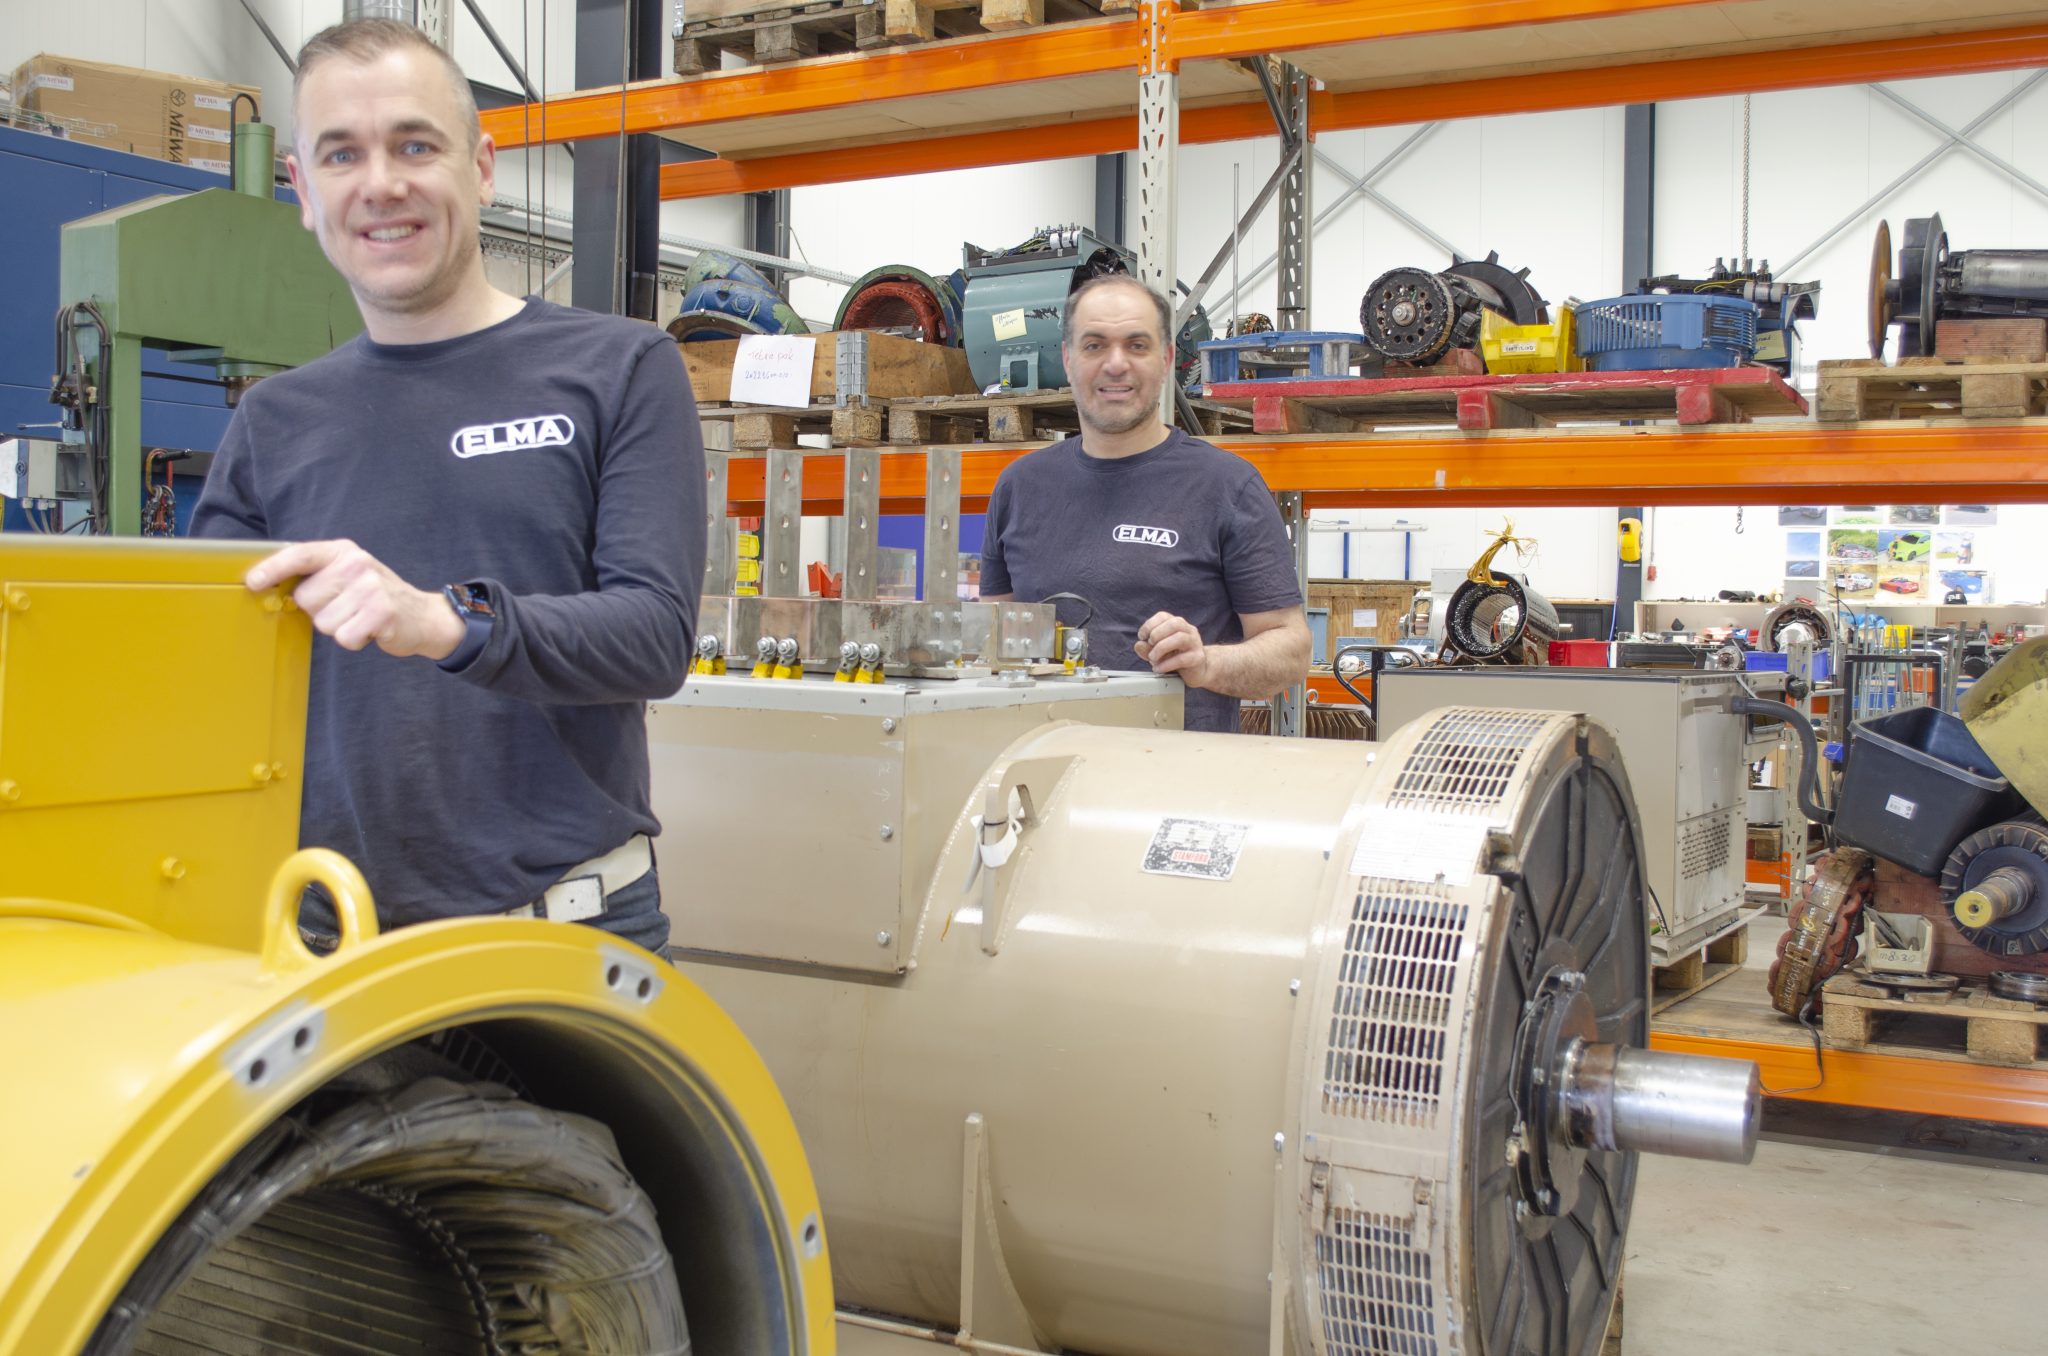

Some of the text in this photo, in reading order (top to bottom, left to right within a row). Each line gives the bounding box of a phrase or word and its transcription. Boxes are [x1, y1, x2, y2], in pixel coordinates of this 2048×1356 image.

[168, 111, 184, 163] MEWA
[462, 419, 566, 454] ELMA
[1118, 526, 1172, 545] ELMA
